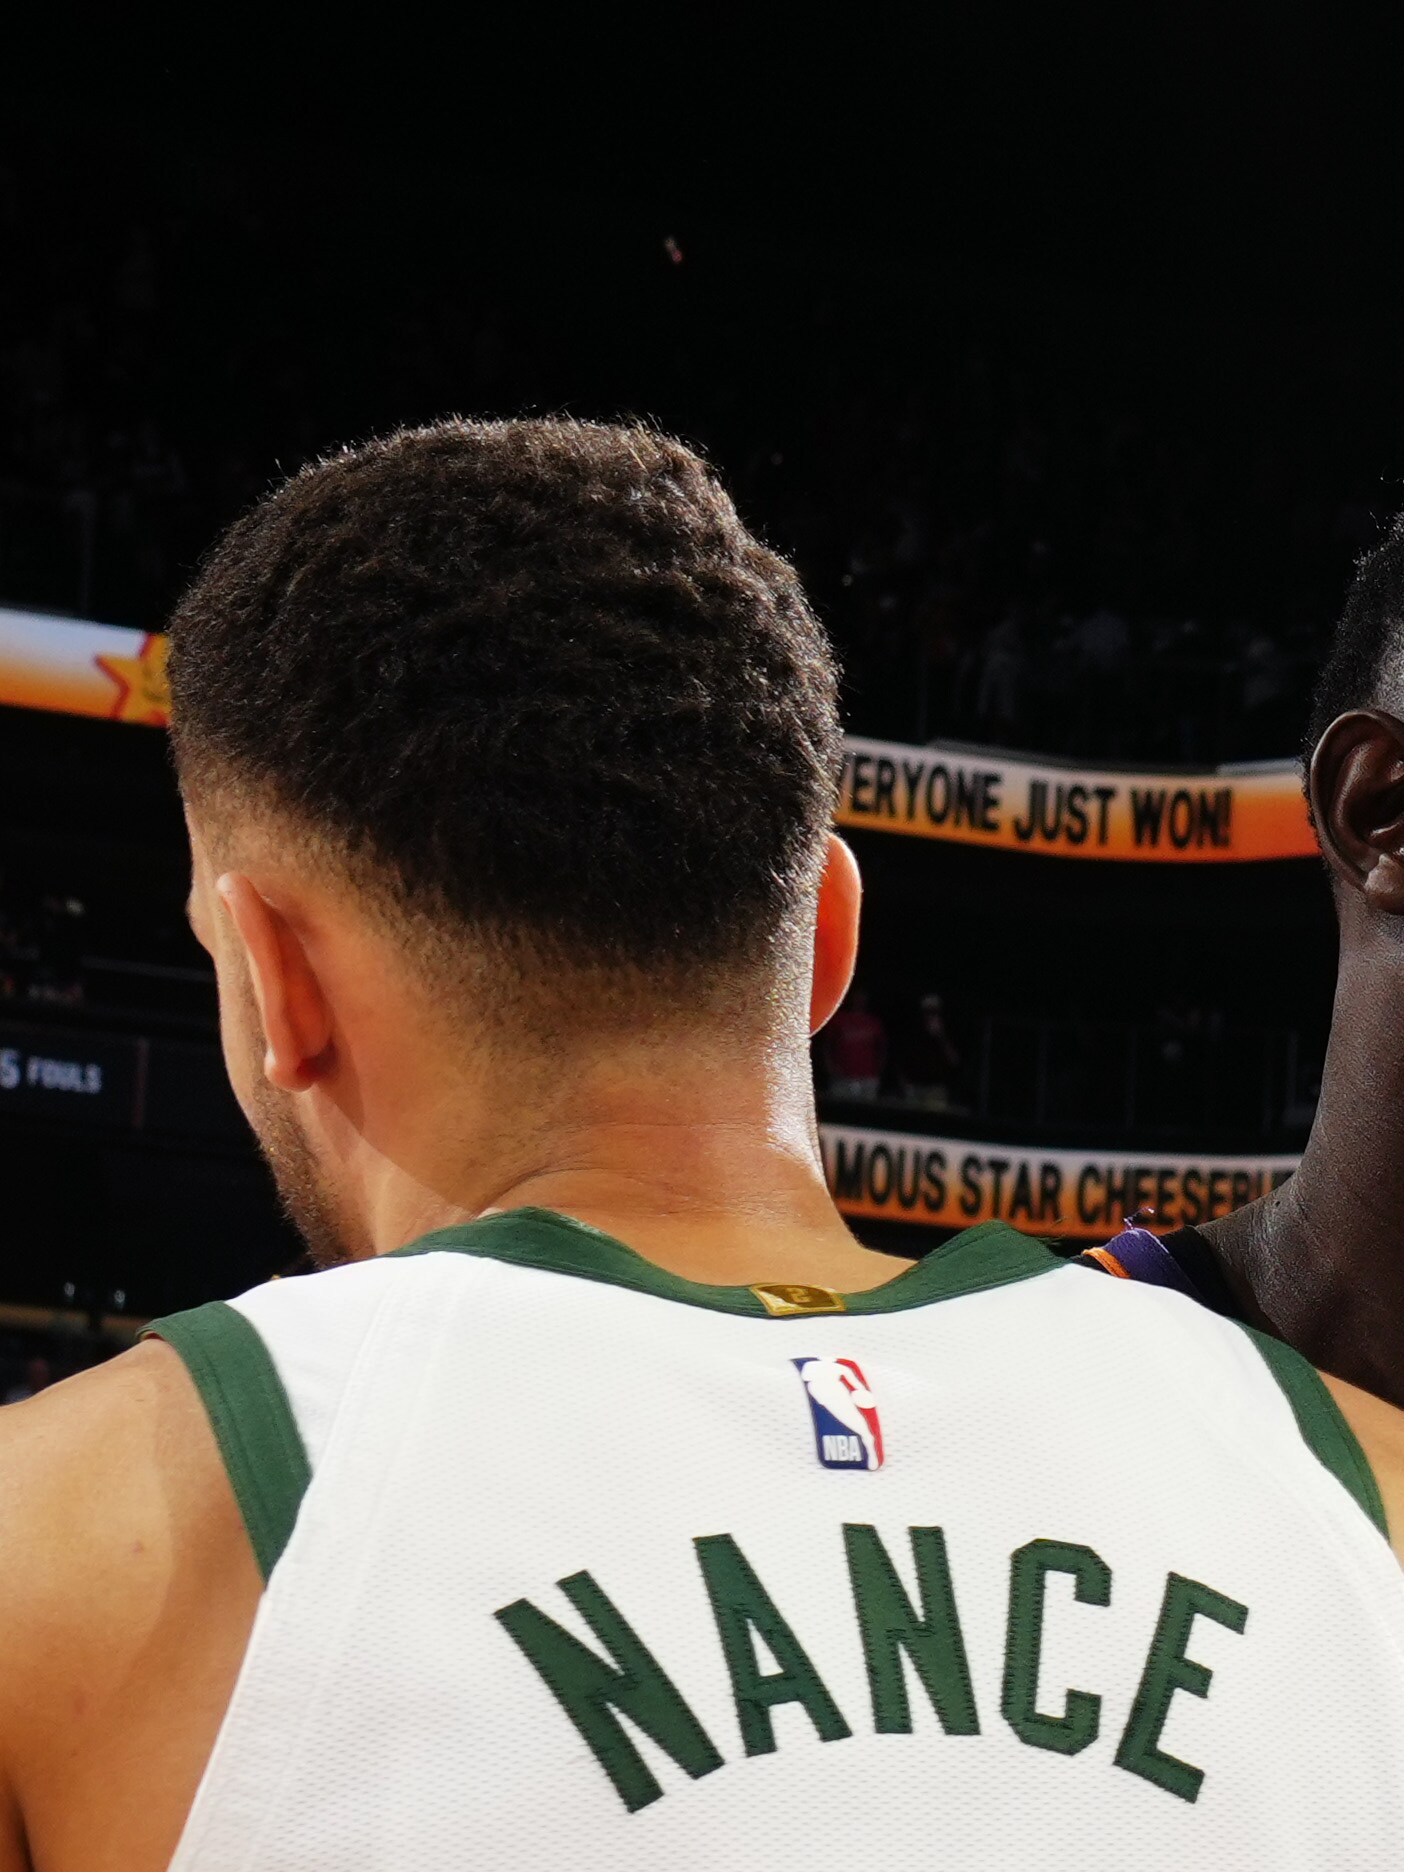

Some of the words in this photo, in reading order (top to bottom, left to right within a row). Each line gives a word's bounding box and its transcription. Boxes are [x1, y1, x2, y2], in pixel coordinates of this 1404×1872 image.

[1013, 780, 1117, 846] JUST
[1129, 786, 1233, 849] WON!
[833, 1138, 948, 1213] MOUS
[959, 1152, 1062, 1222] STAR
[821, 1434, 863, 1462] NBA
[493, 1522, 1250, 1814] NANCE
